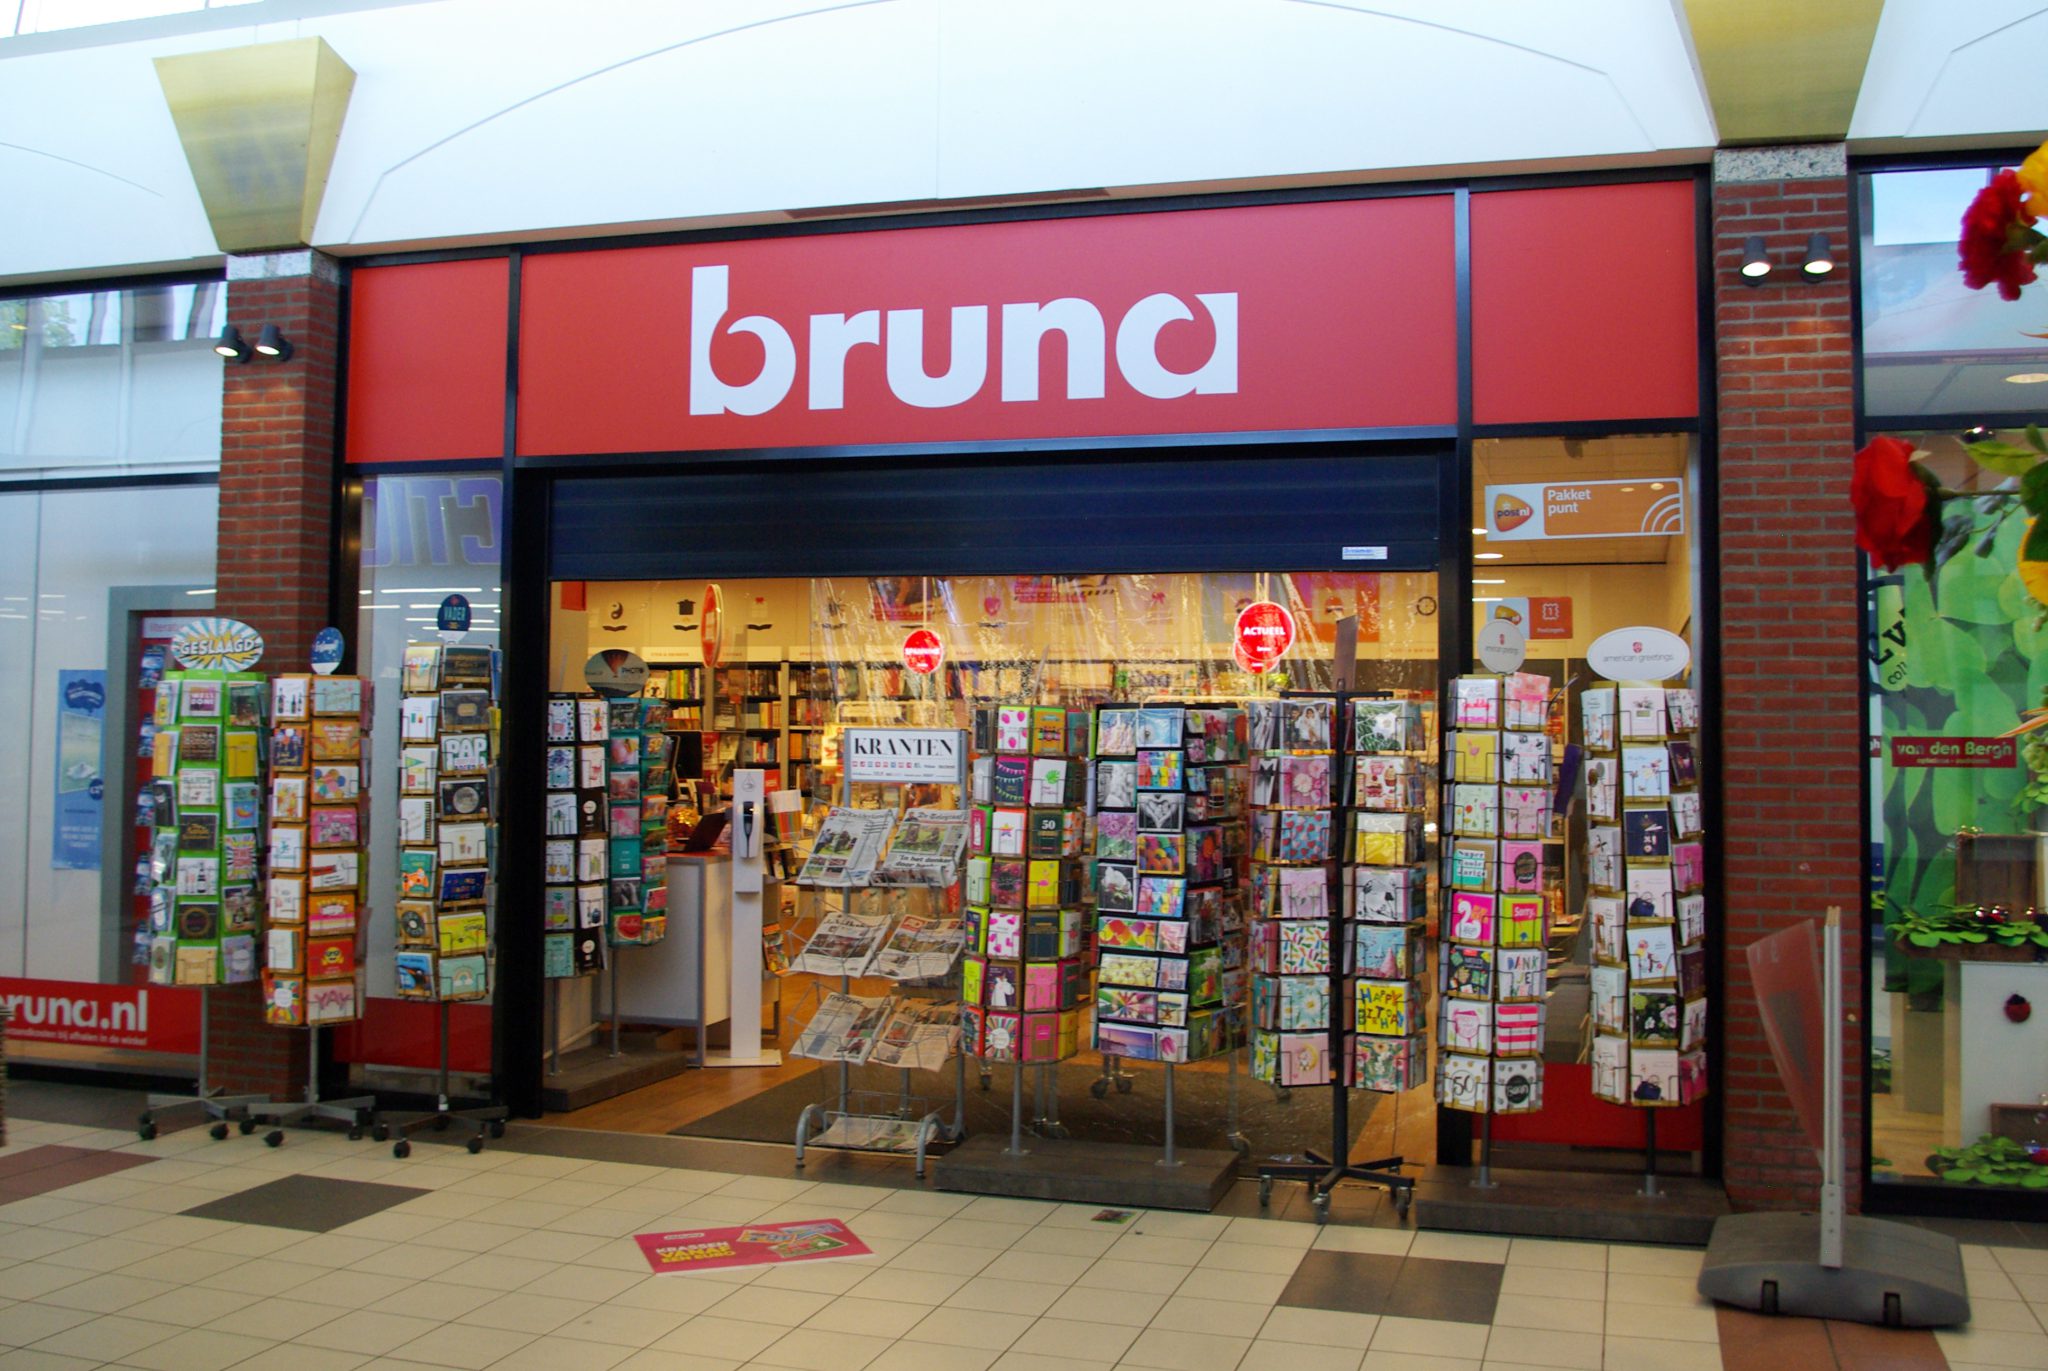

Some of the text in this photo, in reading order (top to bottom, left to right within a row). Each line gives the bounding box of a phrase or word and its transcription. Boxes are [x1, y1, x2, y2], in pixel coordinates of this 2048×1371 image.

[690, 264, 1238, 416] bruna
[1548, 489, 1590, 500] Pakket
[1497, 506, 1530, 518] postnl
[1548, 503, 1579, 516] punt
[1243, 627, 1286, 635] ACTUEEL
[180, 639, 256, 655] GESLAAGD
[1638, 653, 1674, 663] greetings
[854, 737, 954, 756] KRANTEN
[1896, 741, 2012, 759] van den Bergh
[1041, 820, 1056, 830] 50
[1508, 956, 1538, 970] DANK
[1360, 987, 1402, 1006] HAPPY
[0, 990, 148, 1032] runa.nl
